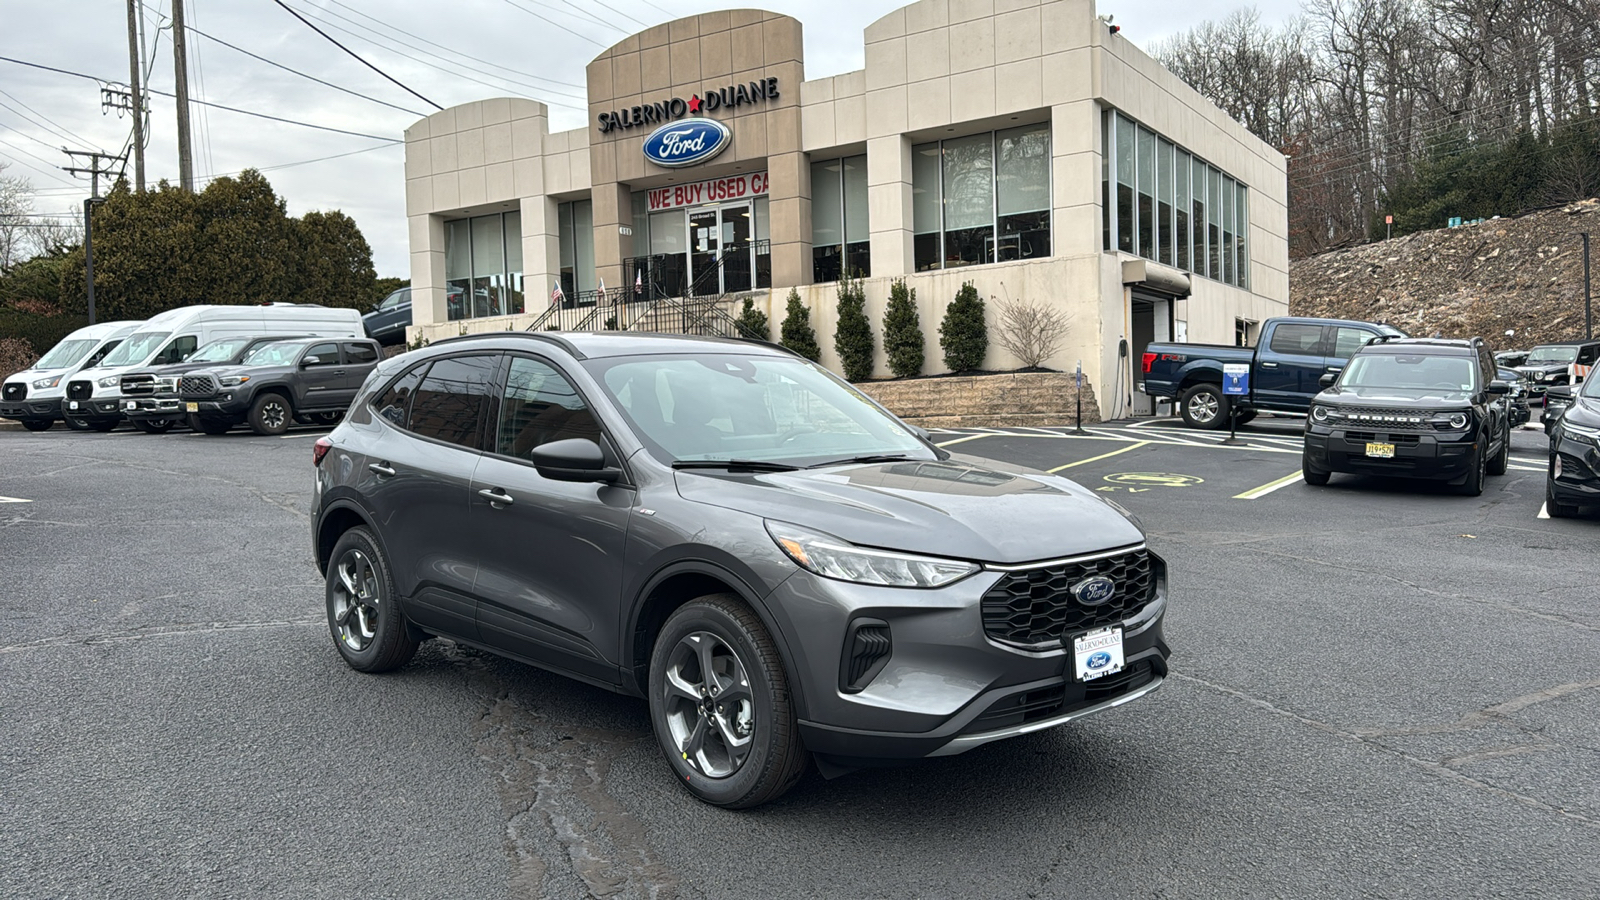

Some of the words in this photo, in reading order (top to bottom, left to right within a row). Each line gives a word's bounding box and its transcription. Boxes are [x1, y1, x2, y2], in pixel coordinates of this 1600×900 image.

[598, 98, 686, 133] SALERNO
[705, 77, 780, 111] DUANE
[659, 128, 706, 158] Ford
[649, 188, 671, 209] WE
[675, 183, 703, 206] BUY
[707, 177, 746, 201] USED
[1348, 414, 1420, 423] BRONCO
[1087, 583, 1108, 599] Ford
[1076, 640, 1100, 652] SALERNO
[1101, 634, 1120, 646] DUANE
[1091, 655, 1107, 667] Ford
